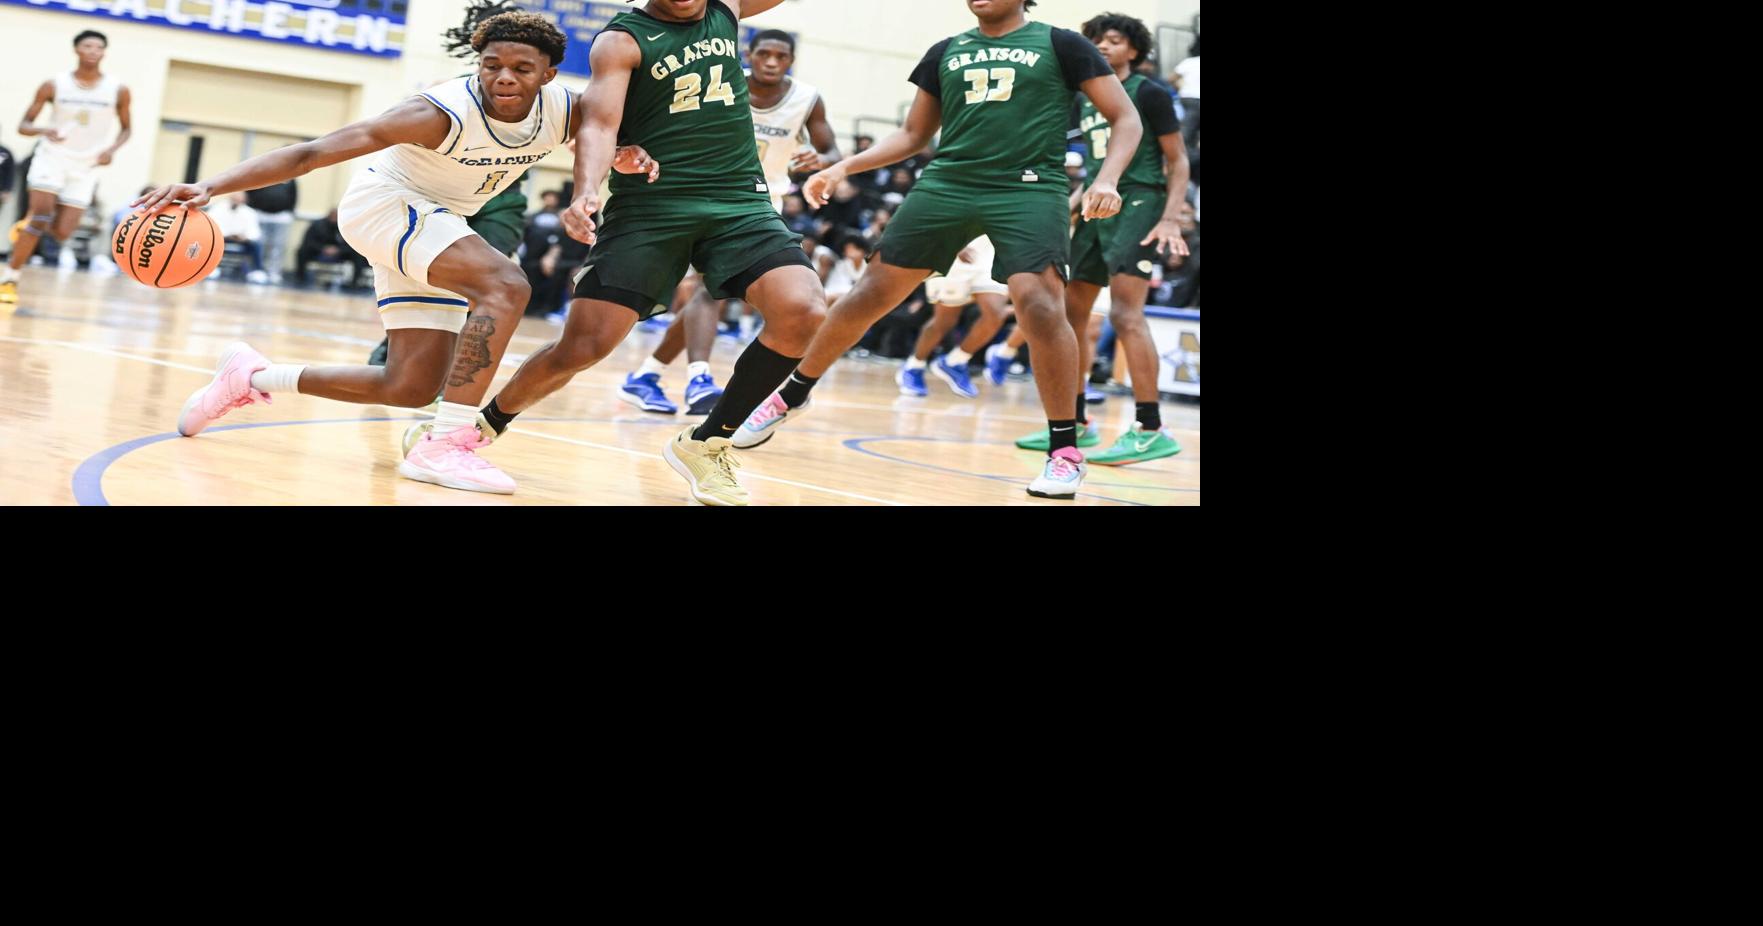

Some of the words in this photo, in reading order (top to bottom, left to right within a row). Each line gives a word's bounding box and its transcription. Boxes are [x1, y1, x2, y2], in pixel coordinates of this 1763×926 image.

[650, 38, 736, 80] GRAYSON
[947, 47, 1041, 71] GRAYSON
[669, 64, 736, 114] 24
[963, 67, 1016, 104] 33
[473, 170, 509, 195] 1
[116, 214, 139, 254] NCAA
[138, 213, 177, 268] Wilson
